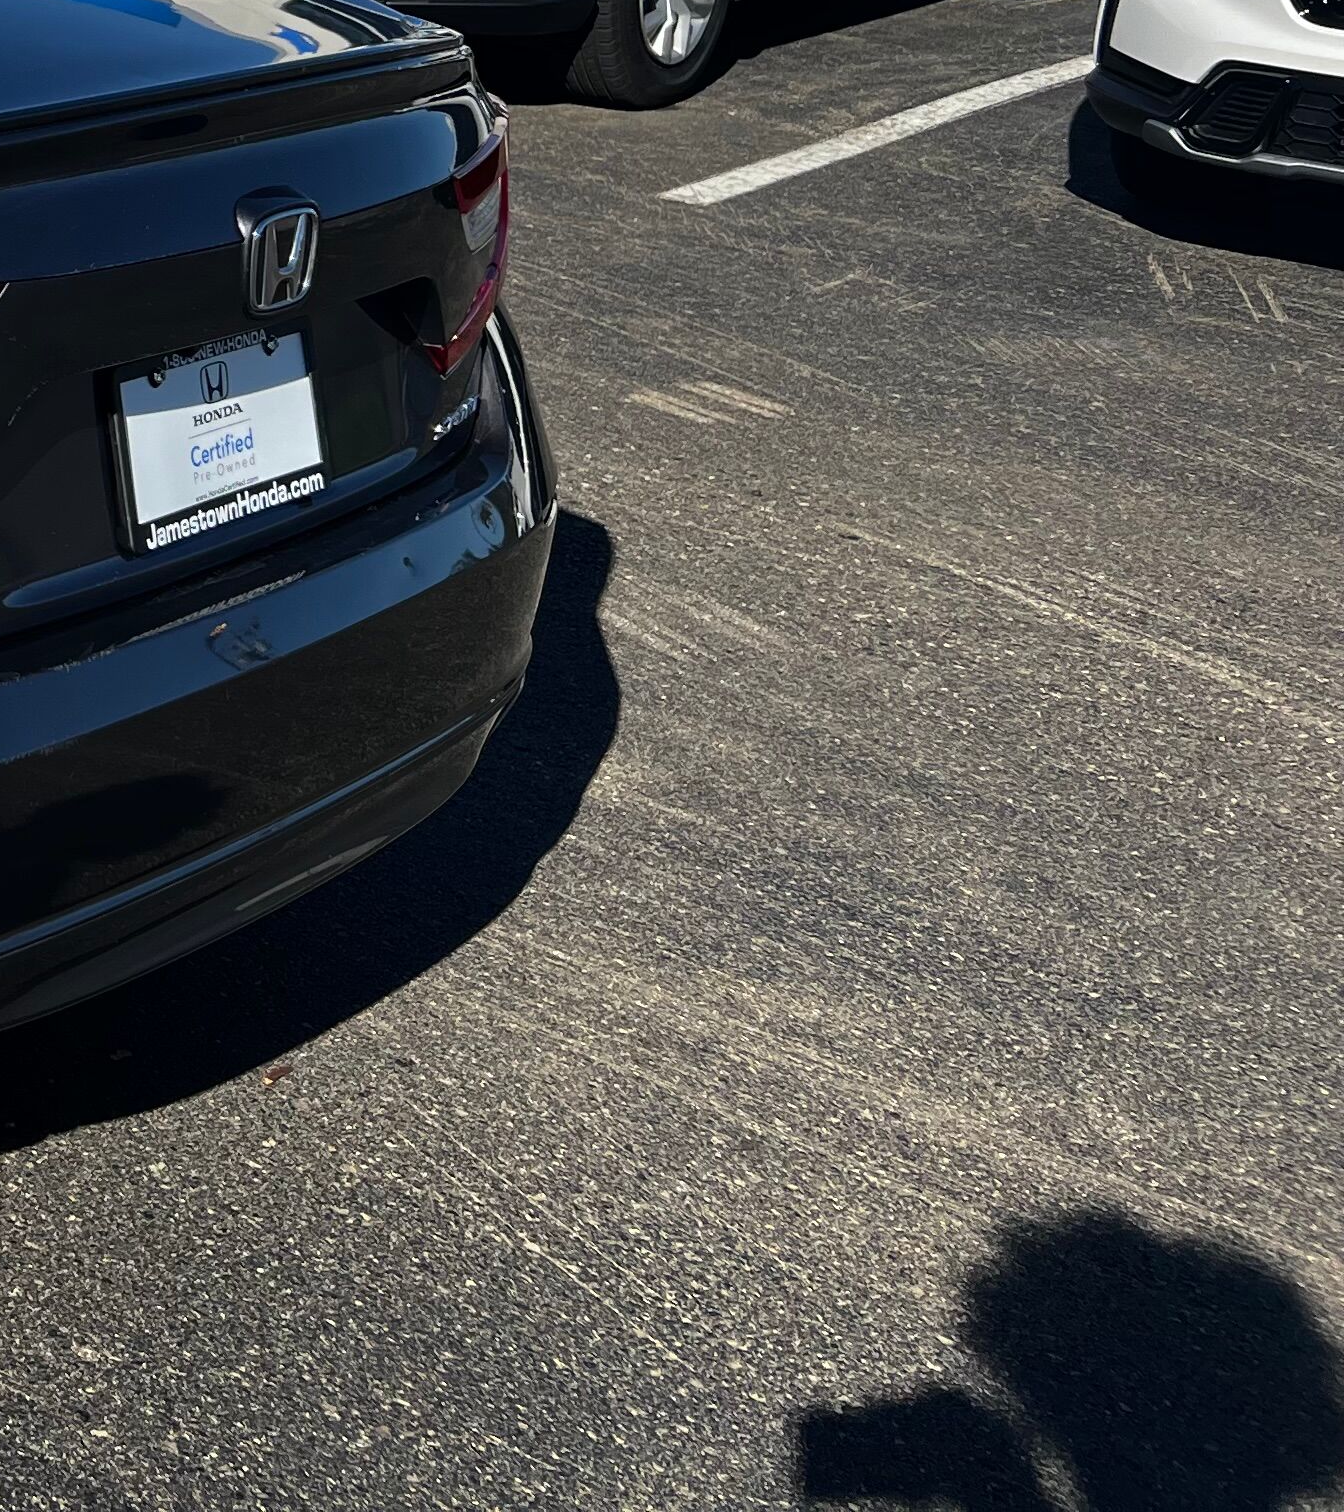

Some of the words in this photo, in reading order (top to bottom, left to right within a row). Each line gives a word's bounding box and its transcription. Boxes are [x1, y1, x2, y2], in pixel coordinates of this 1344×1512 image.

[192, 402, 244, 428] HONDA
[190, 427, 255, 468] Certified
[193, 454, 256, 486] Pre-Owned
[146, 472, 325, 550] JamestownHonda.com
